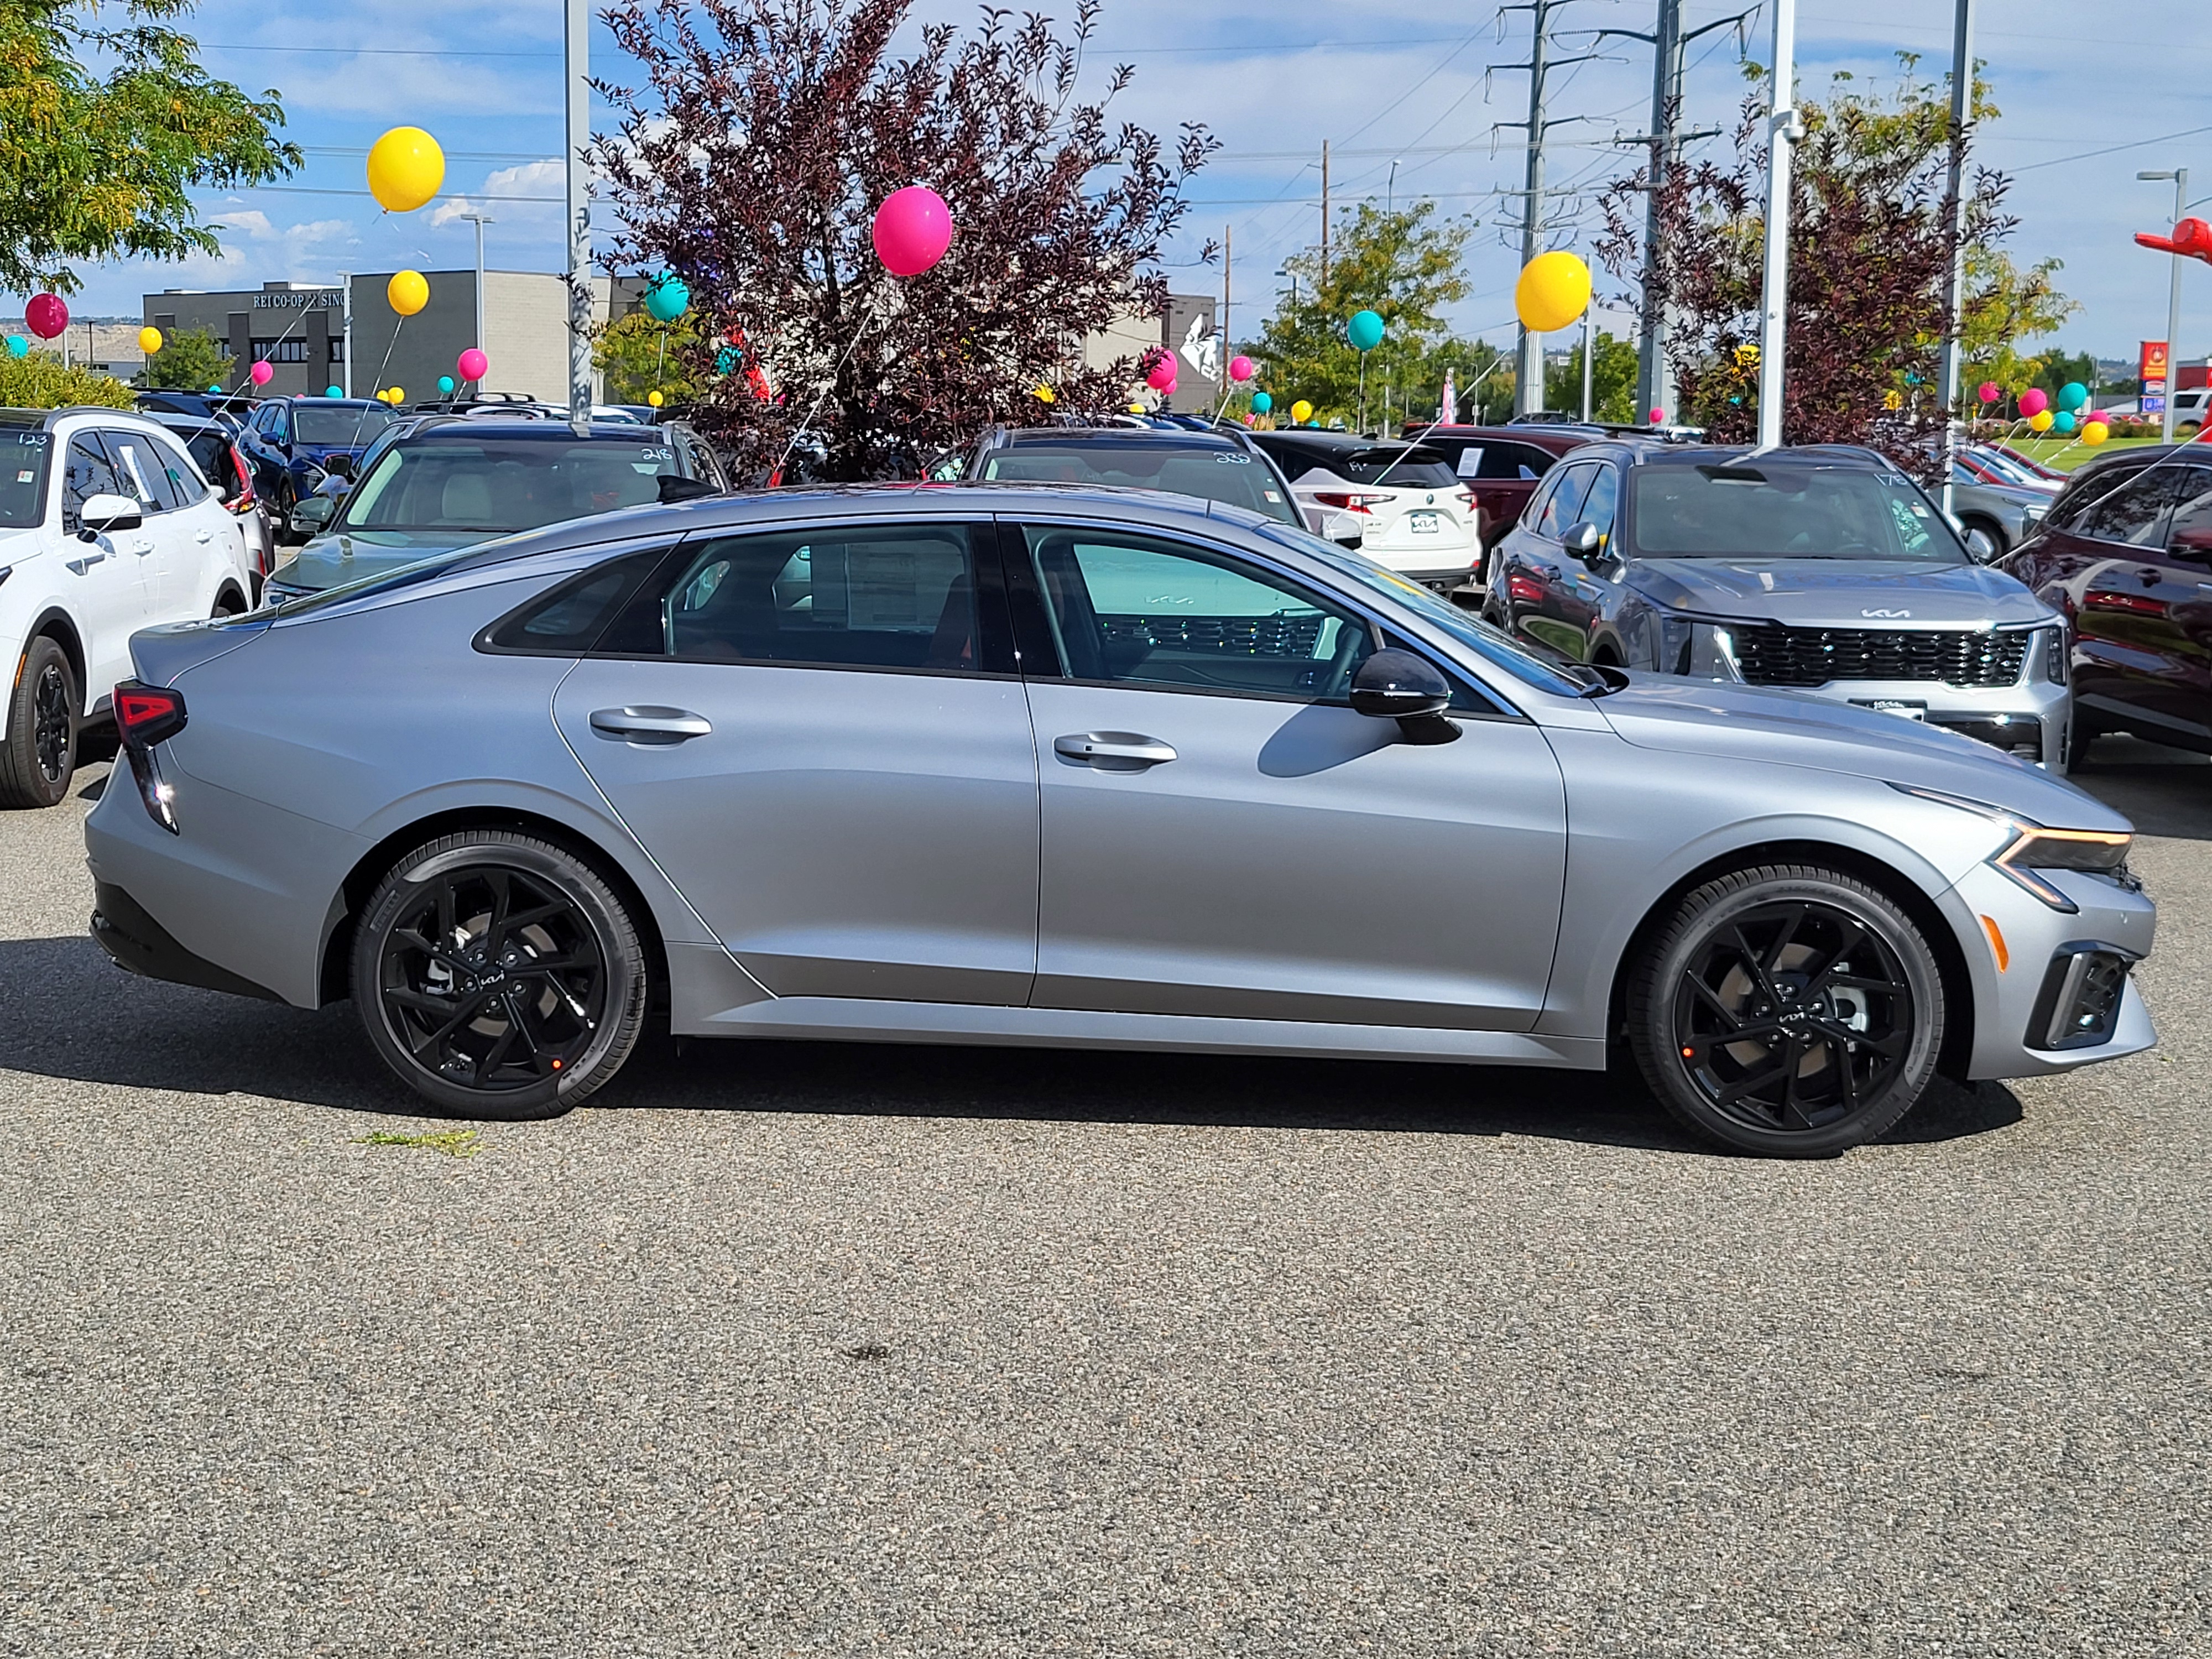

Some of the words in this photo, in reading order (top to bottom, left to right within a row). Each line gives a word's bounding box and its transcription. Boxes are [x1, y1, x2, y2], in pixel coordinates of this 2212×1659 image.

[254, 295, 271, 307] REI
[274, 294, 304, 307] CO-OP
[19, 433, 48, 446] 123
[641, 448, 672, 461] 218
[1213, 452, 1250, 463] 232
